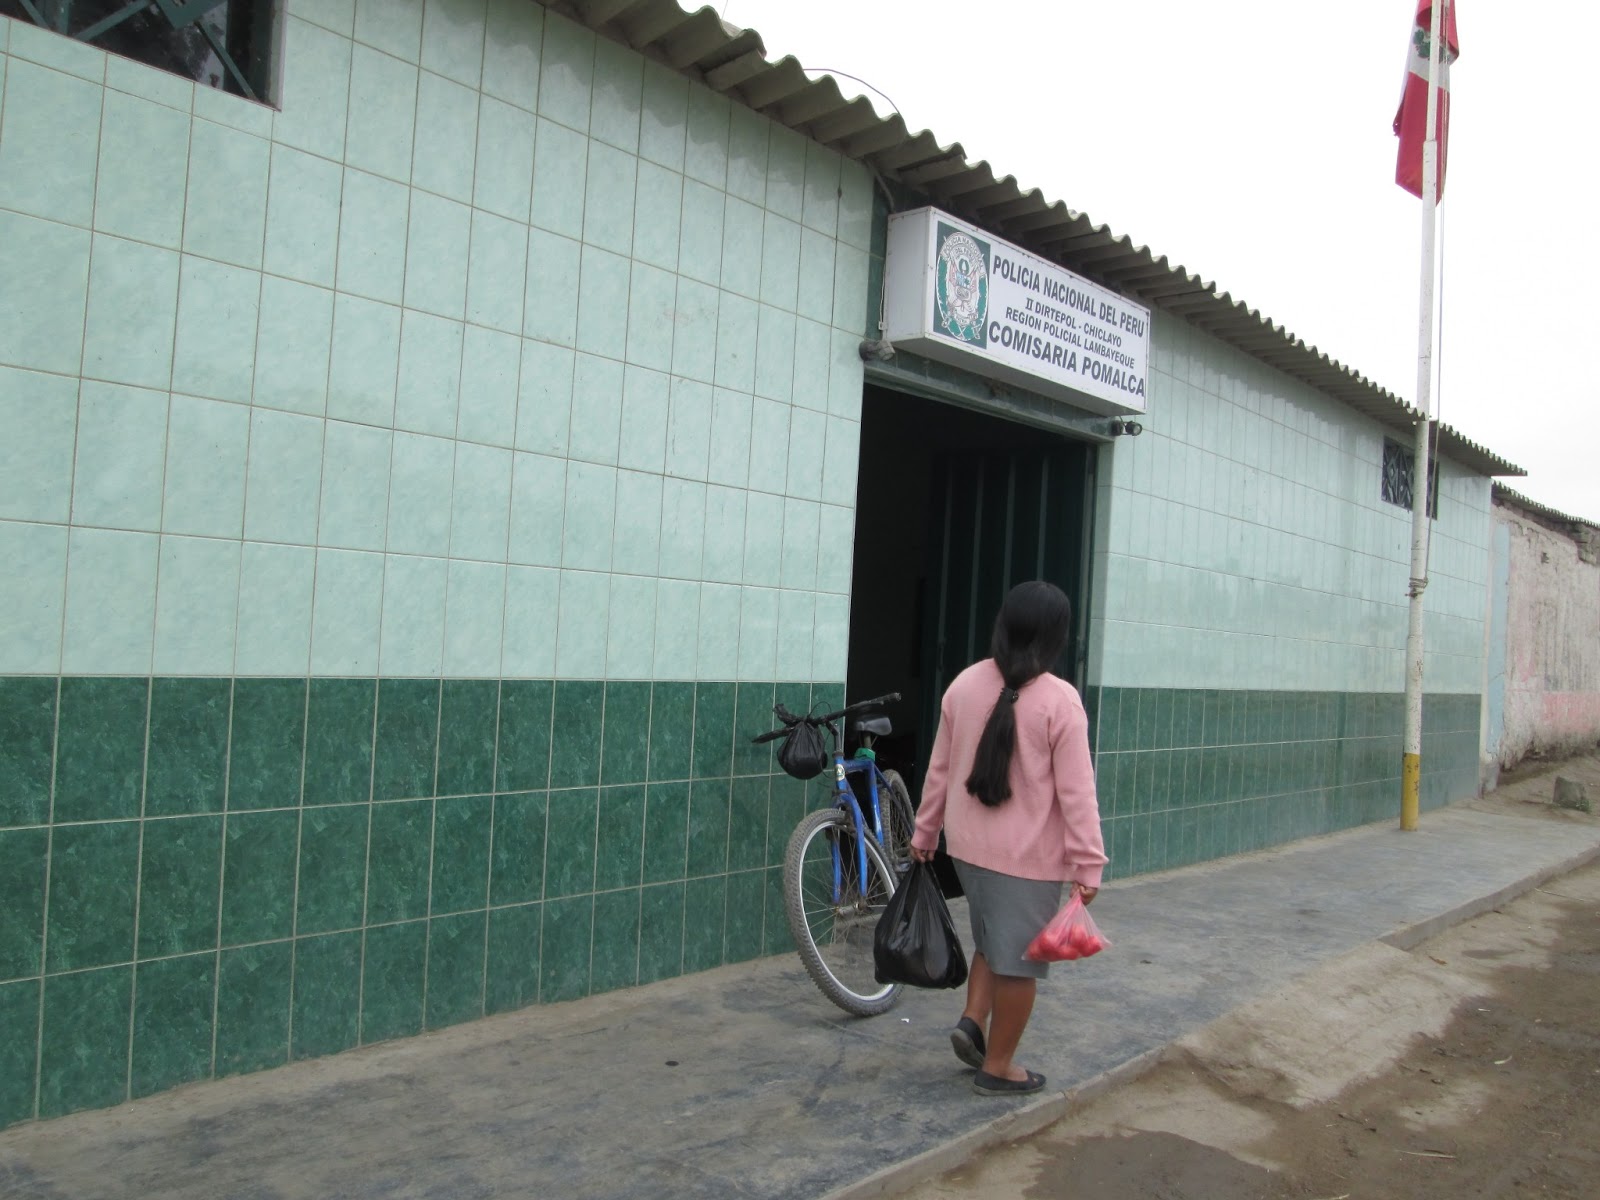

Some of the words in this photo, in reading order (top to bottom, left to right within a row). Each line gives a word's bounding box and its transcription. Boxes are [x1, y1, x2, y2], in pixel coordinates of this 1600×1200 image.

[993, 255, 1040, 292] POLICIA
[1043, 277, 1097, 317] NACIONAL
[1099, 302, 1117, 326] DEL
[1120, 312, 1145, 338] PERU
[1025, 297, 1034, 311] II
[1035, 302, 1076, 330] DIRTEPOL
[1083, 322, 1122, 348] CHICLAYO
[989, 321, 1077, 372] COMISARIA
[1082, 356, 1145, 397] POMALCA
[1006, 306, 1041, 331] REGION
[1043, 321, 1081, 347] POLICIAL
[1084, 338, 1135, 369] LAMBAYEQUE
